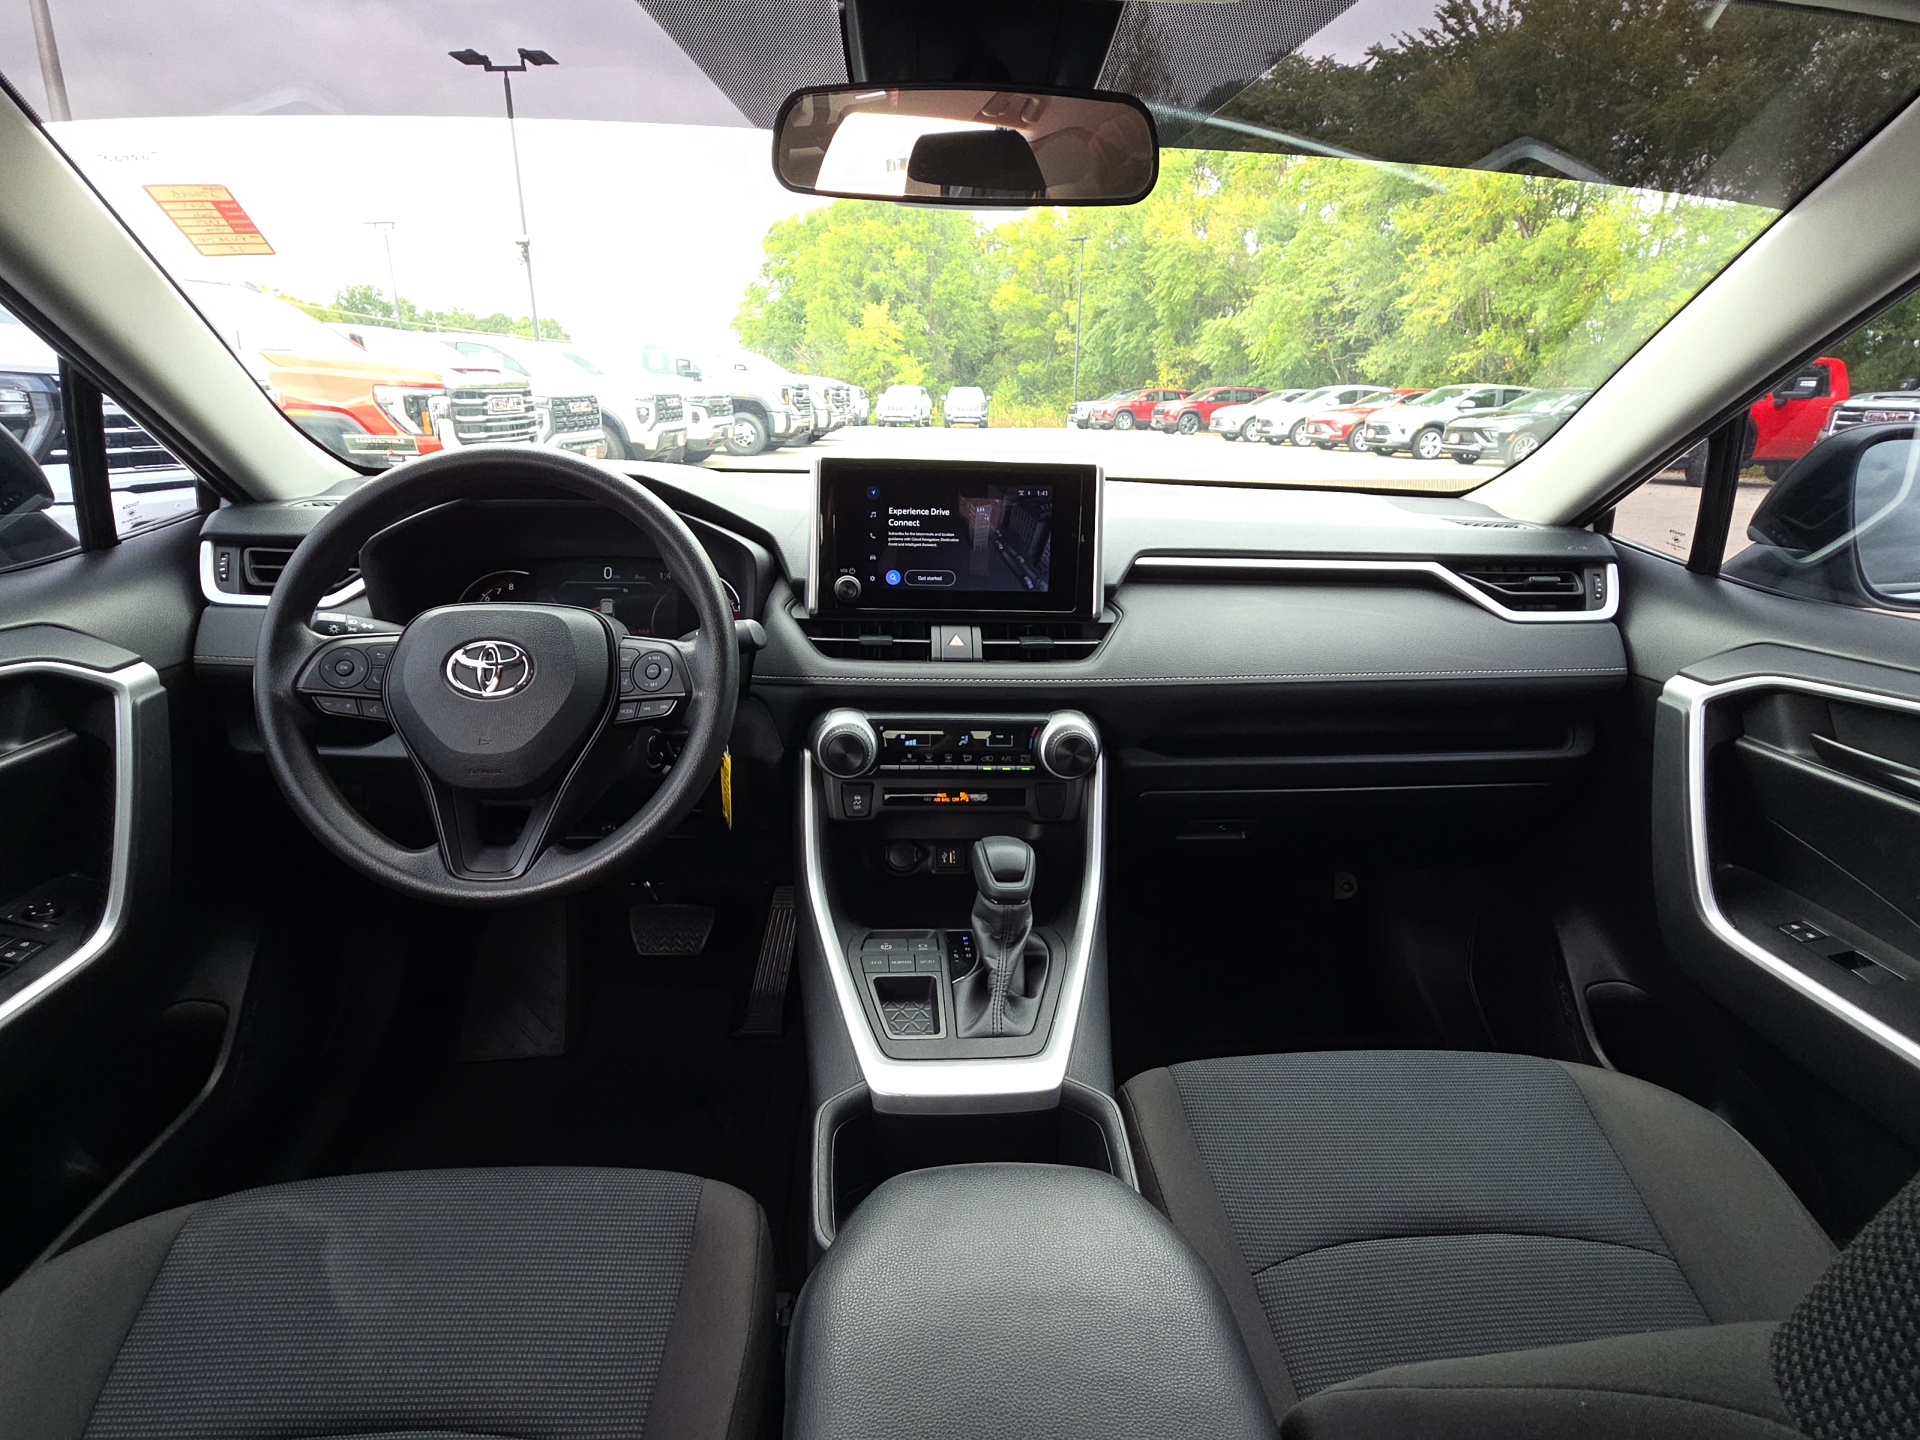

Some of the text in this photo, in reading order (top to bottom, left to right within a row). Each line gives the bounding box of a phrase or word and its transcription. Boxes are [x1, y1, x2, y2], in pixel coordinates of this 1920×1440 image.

[888, 507, 951, 517] Experience Drive
[888, 518, 921, 527] Connect
[603, 566, 613, 580] 0
[496, 587, 502, 595] 7
[508, 583, 515, 591] 8
